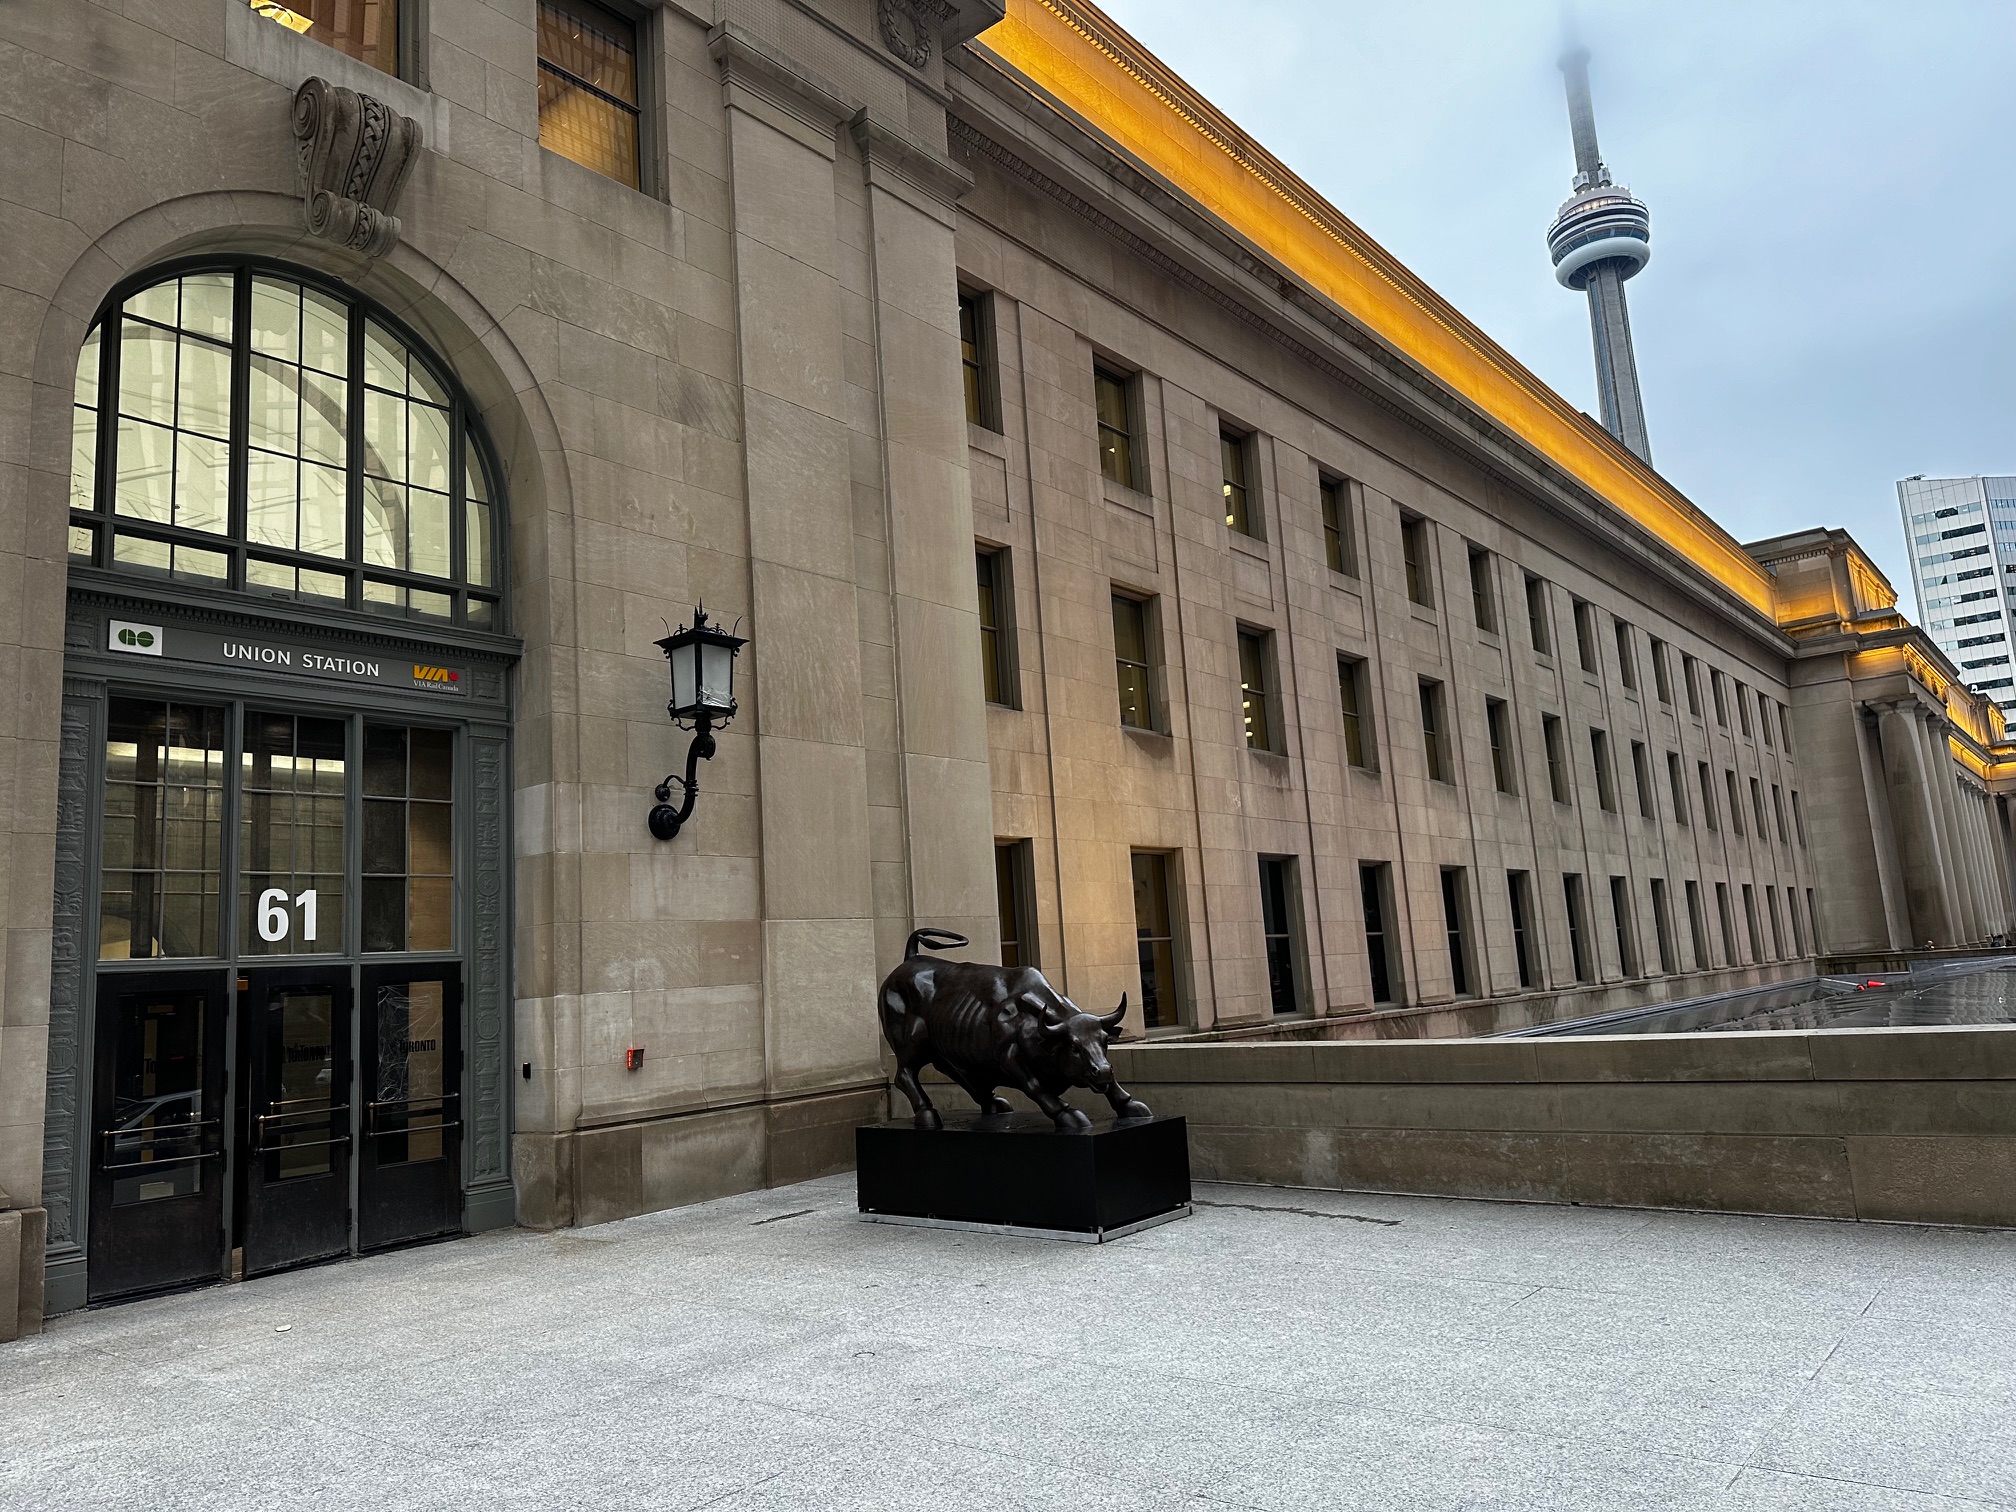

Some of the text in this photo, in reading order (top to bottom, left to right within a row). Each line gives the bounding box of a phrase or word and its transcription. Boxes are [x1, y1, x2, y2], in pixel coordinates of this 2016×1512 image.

[118, 628, 155, 648] GO
[223, 642, 380, 677] UNION STATION
[413, 664, 449, 683] VIA
[413, 680, 459, 692] VIA Rail Canada
[257, 888, 317, 942] 61
